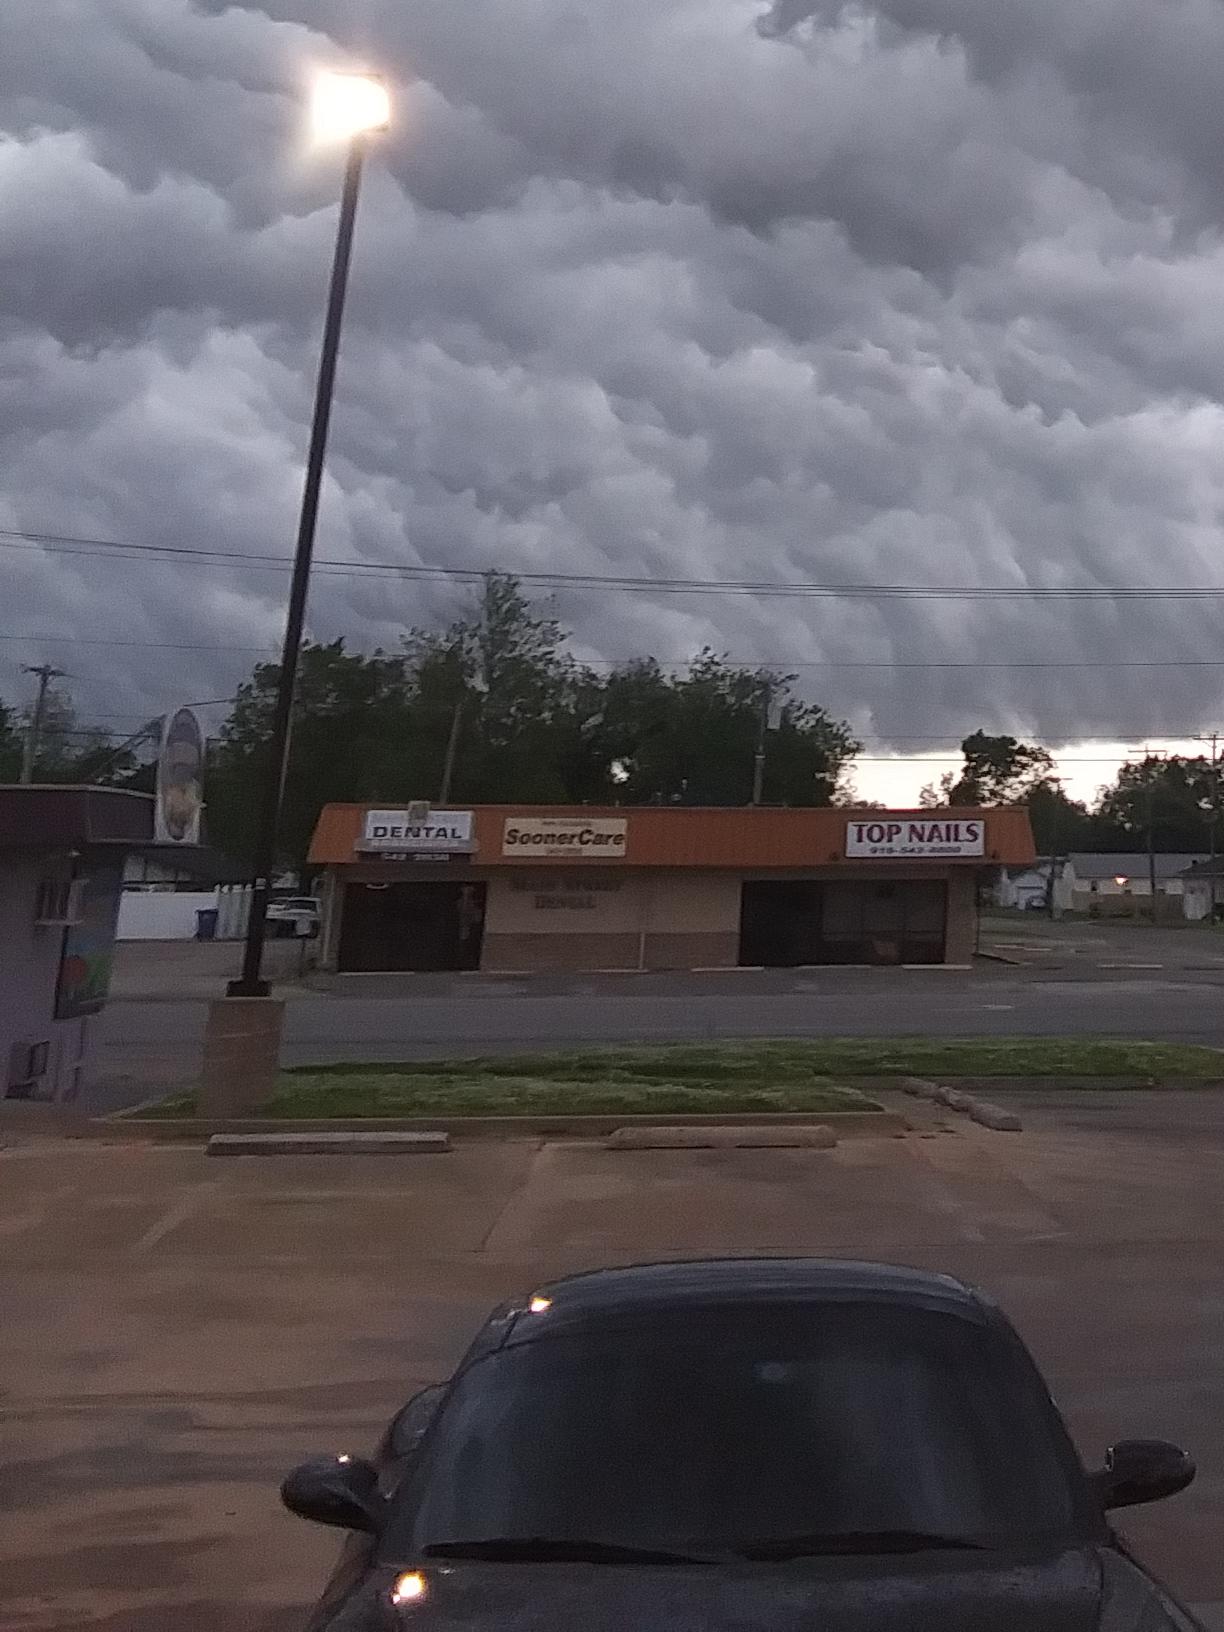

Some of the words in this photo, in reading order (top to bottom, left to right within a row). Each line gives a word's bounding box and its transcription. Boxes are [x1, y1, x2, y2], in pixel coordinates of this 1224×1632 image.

[373, 826, 462, 839] DENTAL
[505, 828, 625, 845] SoonerCare
[852, 823, 902, 843] TOP
[908, 822, 979, 843] NAILS
